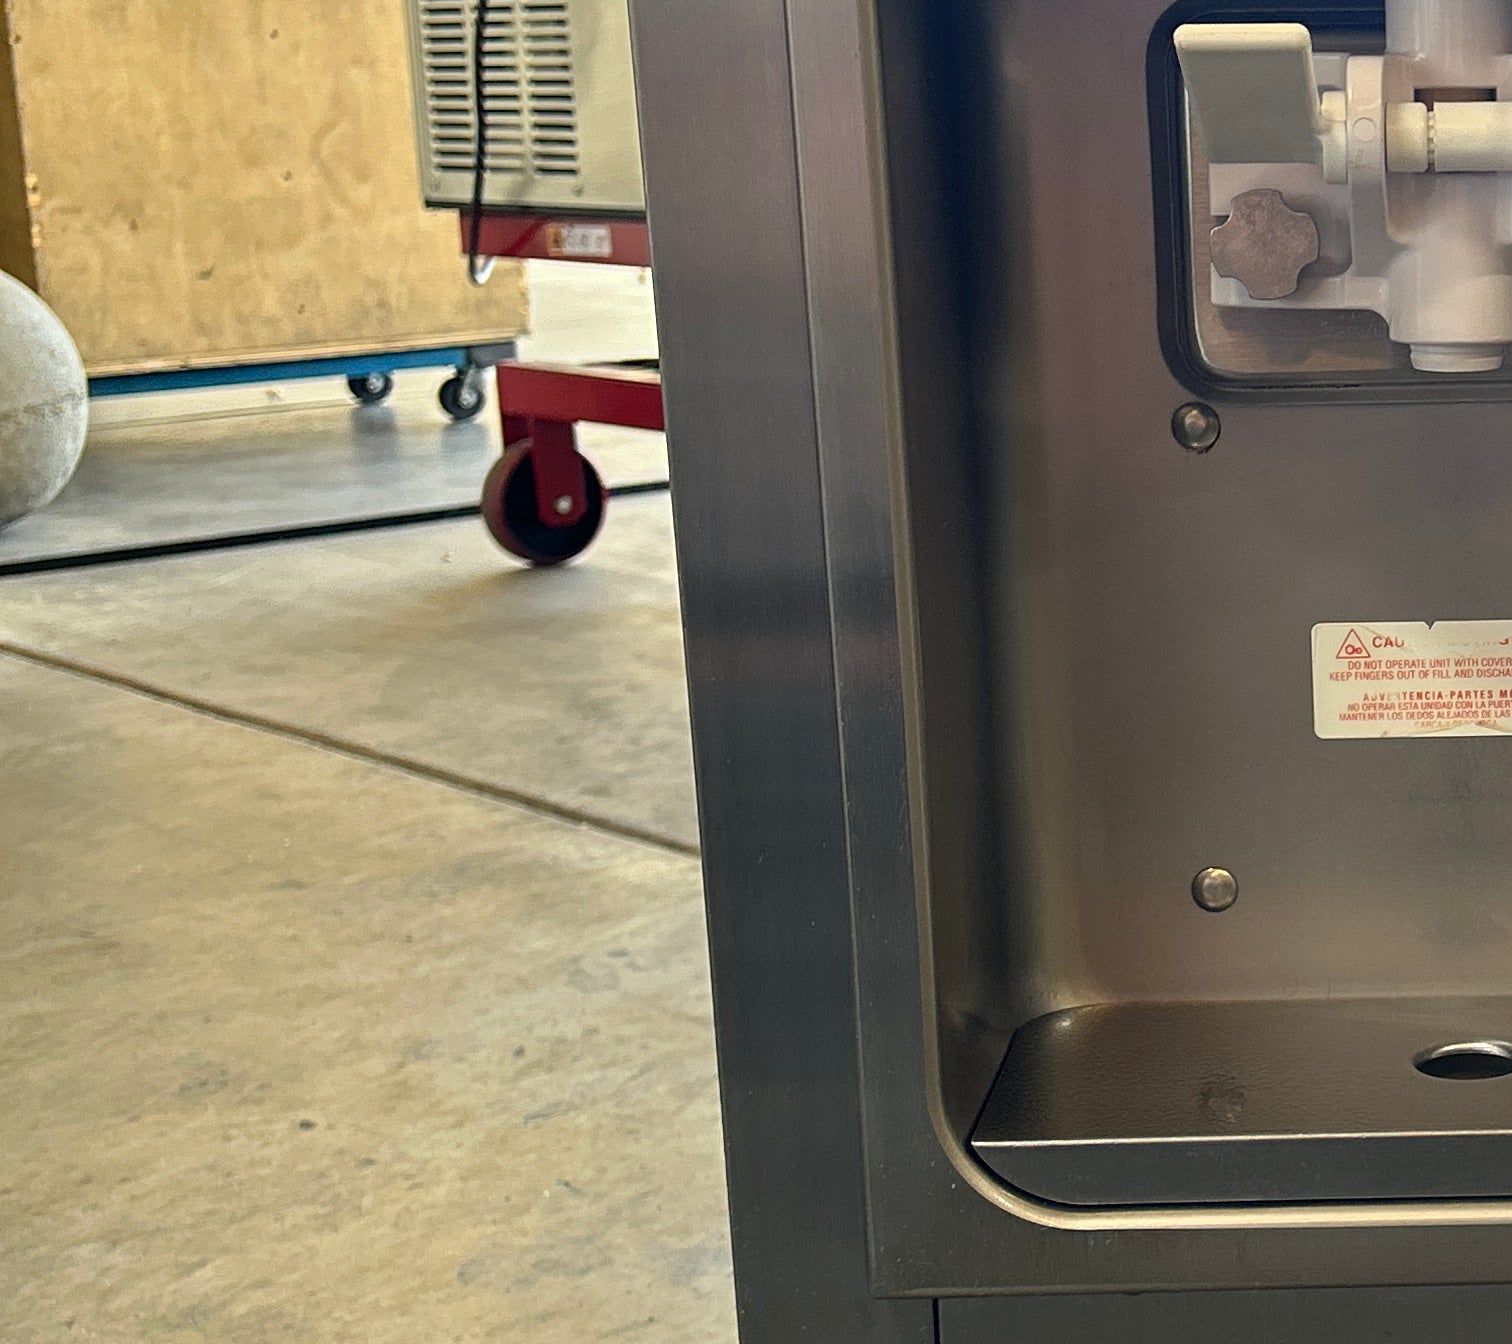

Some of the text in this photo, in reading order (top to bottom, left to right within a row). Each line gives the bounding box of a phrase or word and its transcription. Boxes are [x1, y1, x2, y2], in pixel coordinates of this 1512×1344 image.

[1348, 660, 1361, 670] DO
[1364, 660, 1382, 670] NOT
[1385, 659, 1426, 669] OPERATE
[1429, 658, 1450, 668] UNIT
[1453, 658, 1479, 667] WITH
[1480, 657, 1512, 667] COVER
[1329, 671, 1353, 681] KEEP
[1355, 670, 1394, 680] FINGERS
[1396, 670, 1415, 680] OUT
[1418, 669, 1430, 679] OF
[1432, 669, 1451, 679] FILL
[1454, 668, 1474, 678] AND
[1347, 703, 1360, 712] NO
[1362, 702, 1395, 712] OPERAR
[1398, 701, 1419, 711] ESTA
[1421, 701, 1453, 710] UNIDAD
[1455, 700, 1473, 709] CON
[1475, 700, 1486, 709] LA
[1339, 712, 1385, 721] MANTENER
[1387, 711, 1404, 721] LOS
[1405, 711, 1435, 720] DEDOS
[1436, 709, 1479, 719] ALEJADOS
[1481, 709, 1492, 718] DE
[1494, 708, 1511, 718] LAS
